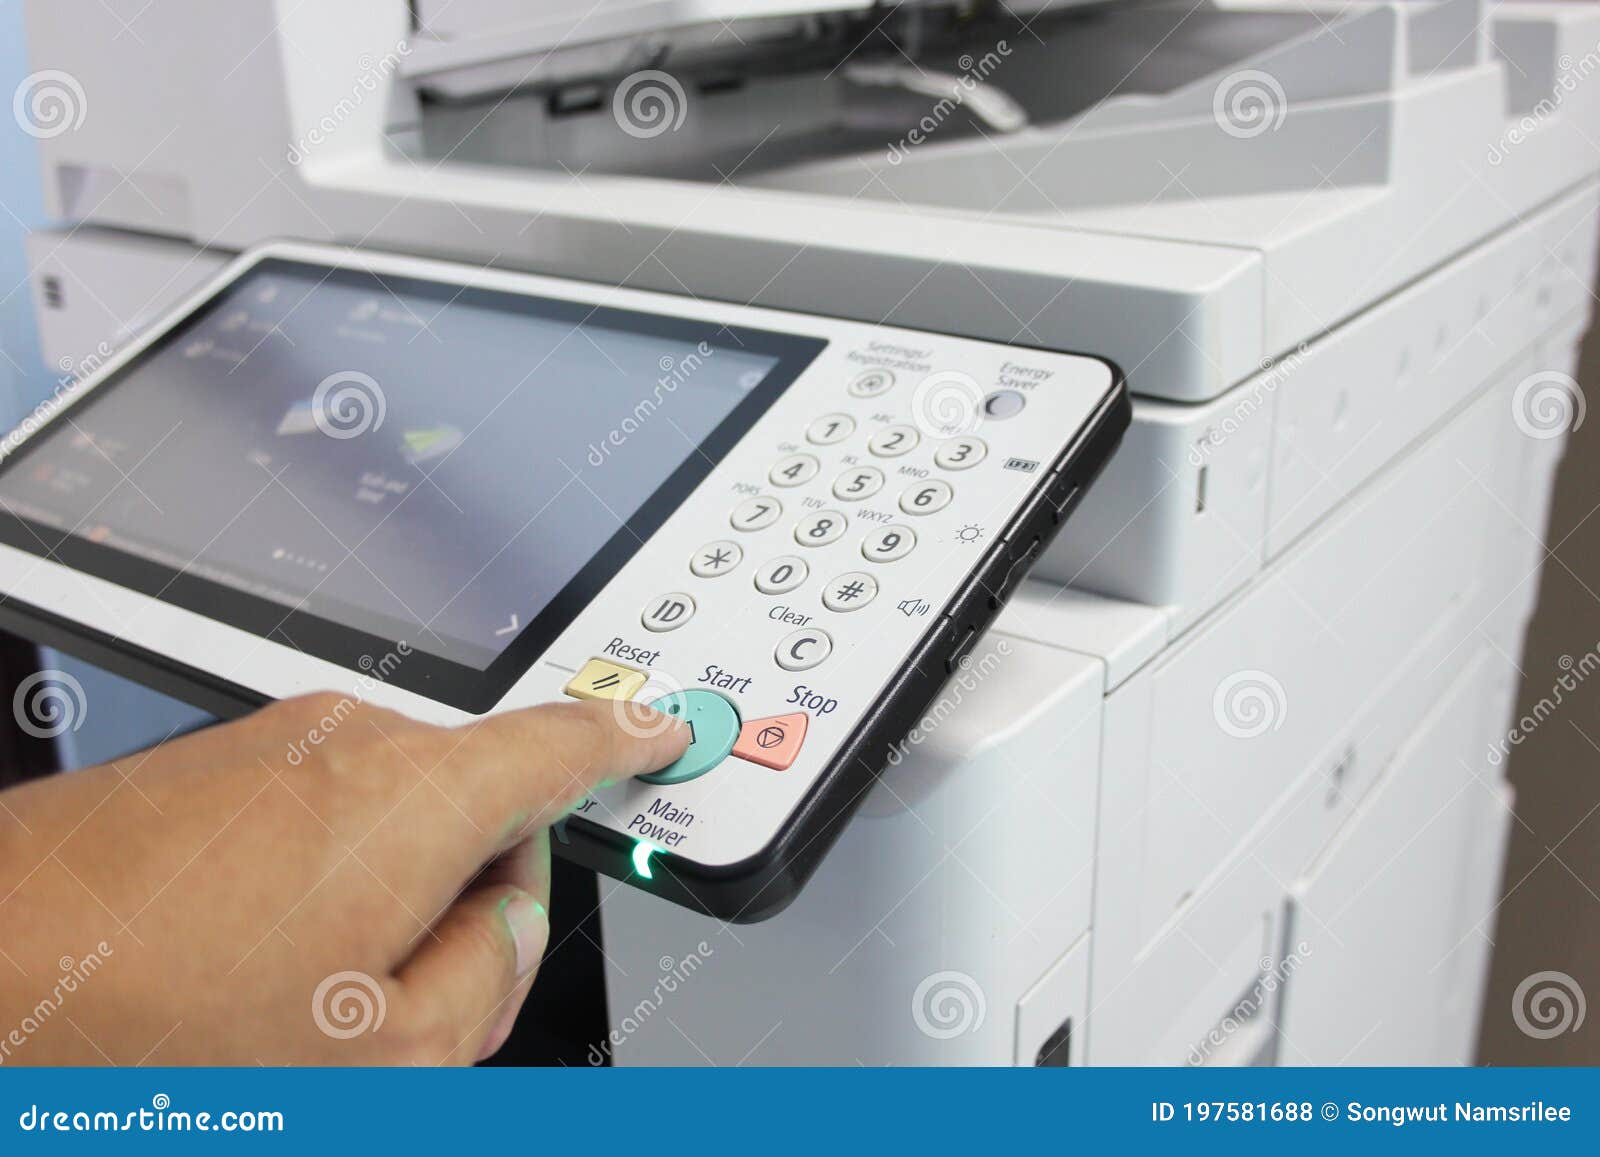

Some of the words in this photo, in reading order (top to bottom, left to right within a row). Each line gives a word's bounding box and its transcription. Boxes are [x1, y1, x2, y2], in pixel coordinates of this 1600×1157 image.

[1000, 361, 1054, 380] Energy
[997, 374, 1040, 391] Saver
[824, 422, 839, 438] 1
[881, 432, 904, 449] 2
[949, 443, 972, 462] 3
[782, 462, 804, 479] 4
[898, 466, 929, 479] MNO
[847, 475, 871, 492] 5
[802, 497, 826, 509] TUV
[914, 488, 937, 506] 6
[745, 504, 770, 522] 7
[857, 508, 893, 524] WXYZ
[809, 519, 833, 538] 8
[877, 532, 901, 552] 9
[770, 564, 794, 584] 0
[837, 580, 864, 602] #
[651, 600, 685, 623] ID
[768, 605, 813, 626] Clear
[604, 637, 660, 667] Reset
[790, 638, 817, 660] C
[698, 665, 752, 694] Start
[786, 685, 838, 717] Stop
[647, 798, 695, 828] Main
[627, 814, 688, 847] Power
